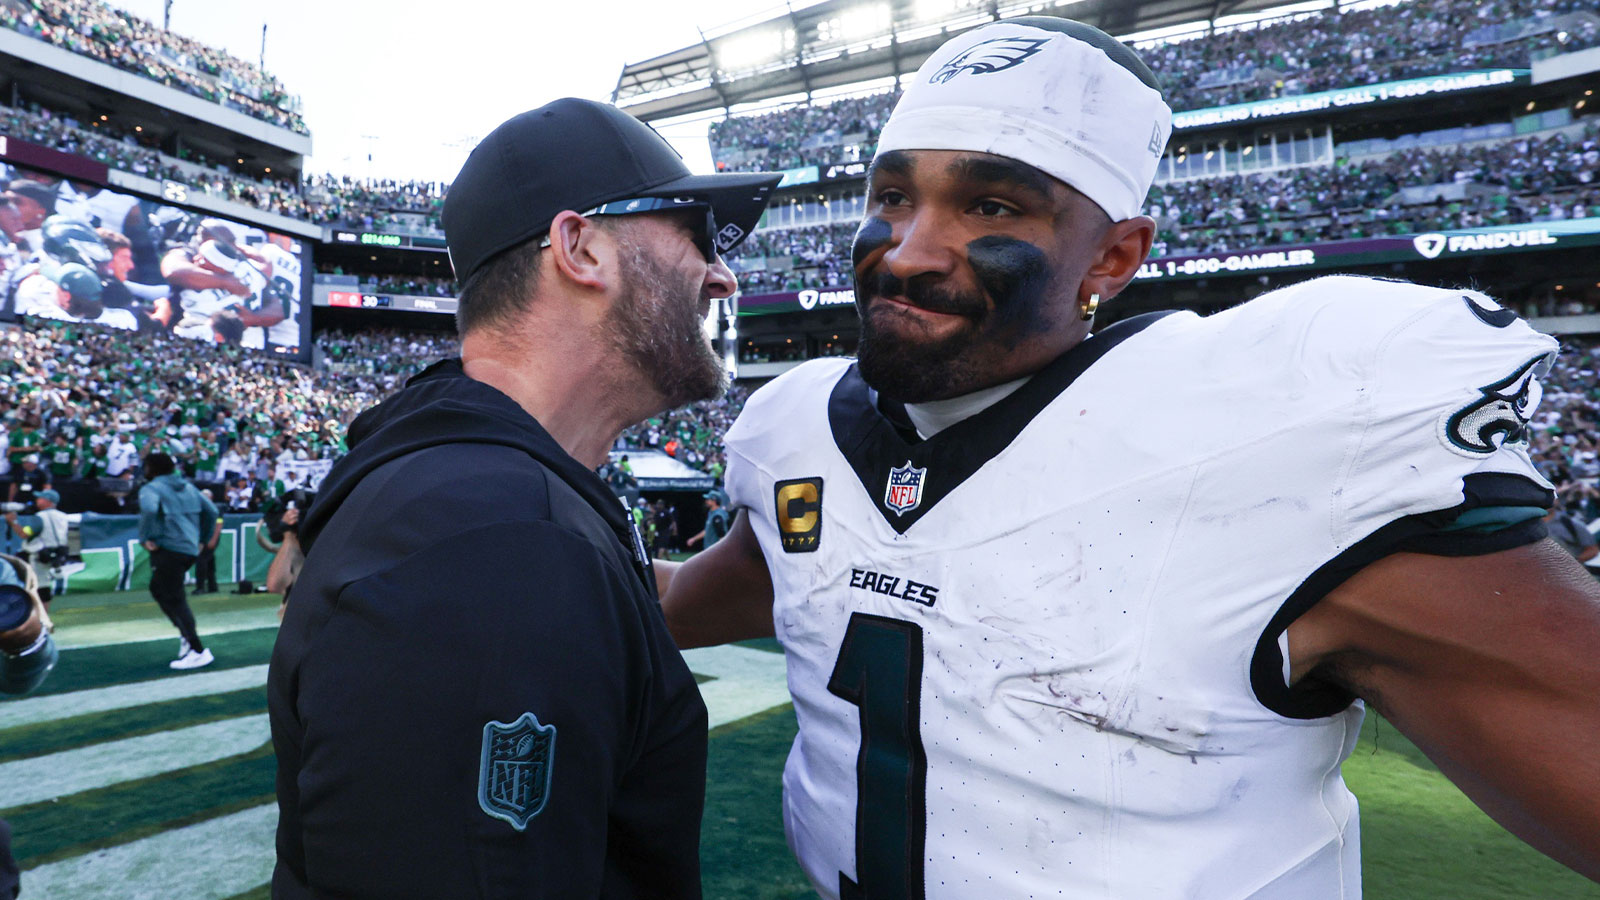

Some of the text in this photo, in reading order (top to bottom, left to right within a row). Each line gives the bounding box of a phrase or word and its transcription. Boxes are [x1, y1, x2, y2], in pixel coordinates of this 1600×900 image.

[1333, 90, 1376, 106] CALL
[1379, 69, 1515, 100] 1-800-GAMBLER
[719, 225, 741, 245] 43
[1450, 229, 1558, 252] FANDUEL
[1166, 250, 1316, 277] 1-800-GAMBLER
[777, 482, 819, 533] C
[889, 485, 916, 506] NFL
[850, 568, 940, 608] EAGLES
[827, 611, 928, 900] 1
[491, 761, 546, 808] NFL
